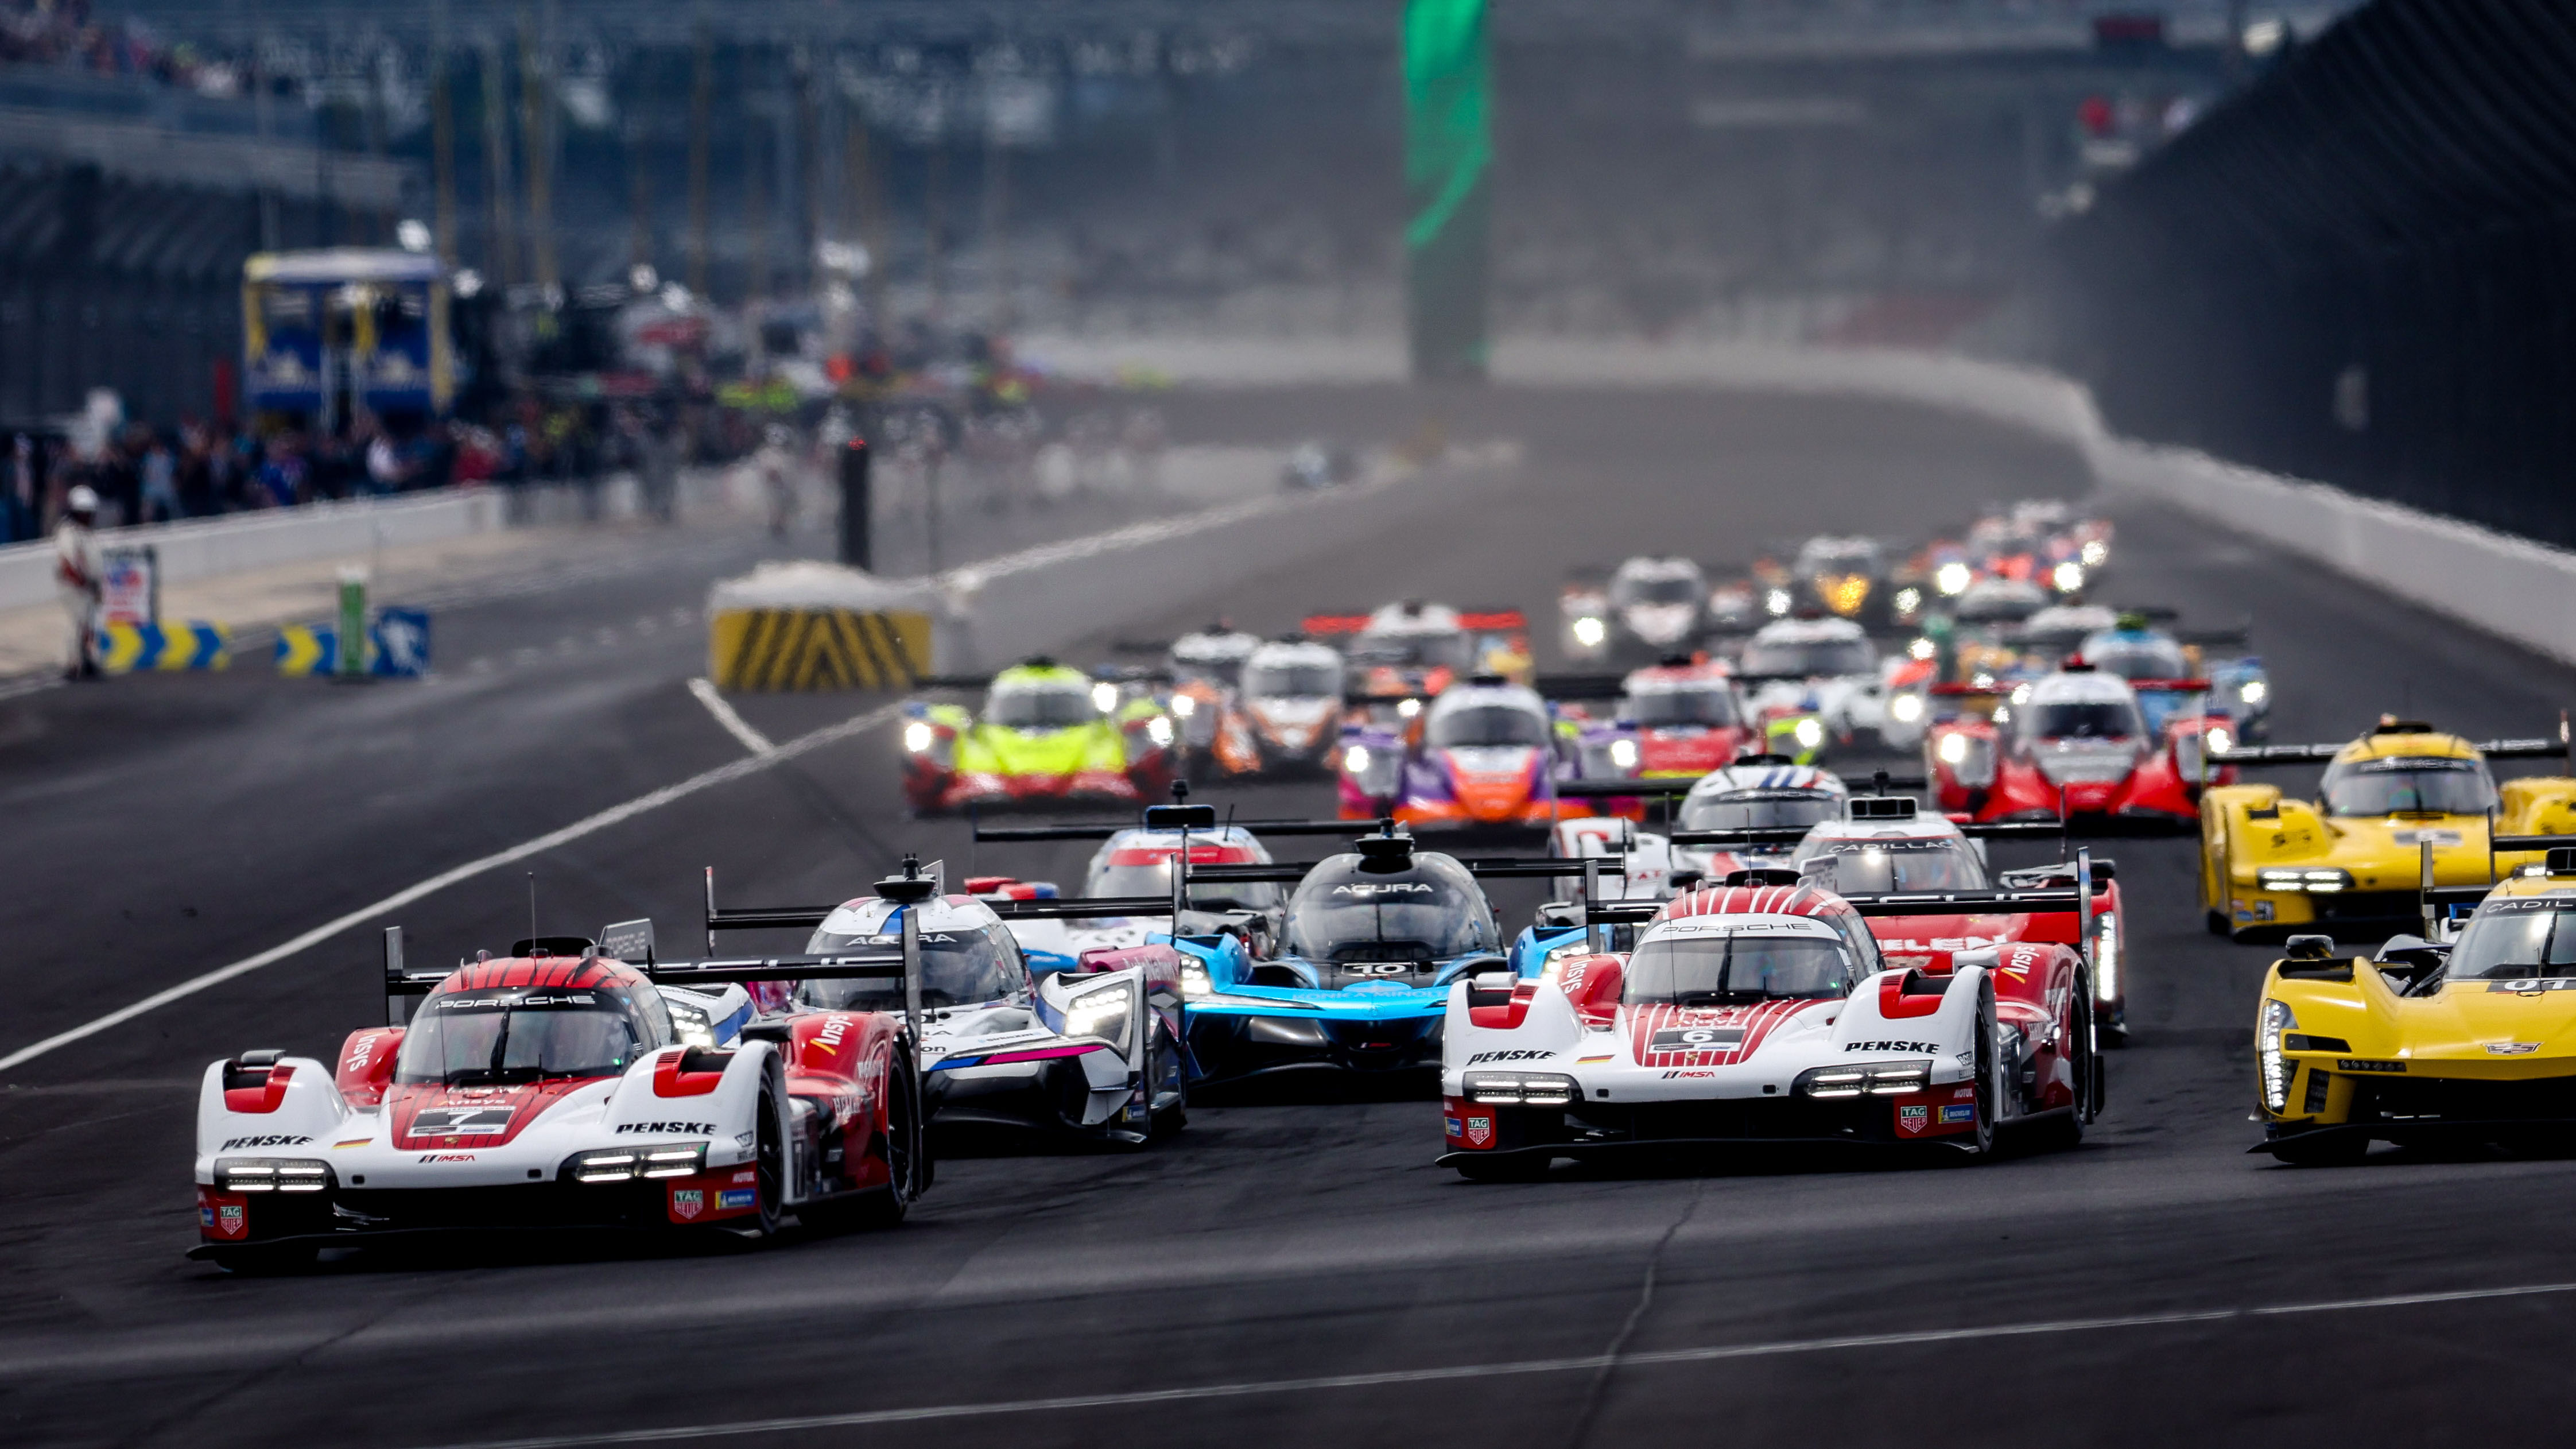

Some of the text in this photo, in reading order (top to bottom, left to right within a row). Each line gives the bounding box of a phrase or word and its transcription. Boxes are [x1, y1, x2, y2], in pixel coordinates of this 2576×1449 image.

[1828, 841, 1953, 853] CADILLAC
[1332, 884, 1433, 894] ACURA
[1661, 923, 1812, 934] PORSCHE
[1353, 964, 1406, 974] 10
[2000, 945, 2040, 985] Ansys
[2504, 979, 2567, 990] 01
[1293, 991, 1367, 1000] KONICA
[435, 995, 596, 1010] PORSCHE
[810, 1014, 854, 1056] Ansys
[1682, 1030, 1714, 1043] 6
[1844, 1041, 1939, 1055] PENSKE
[1466, 1050, 1557, 1066] PENSKE
[1953, 1088, 1973, 1098] MOTUL
[1903, 1108, 1925, 1116] TAG
[448, 1111, 483, 1126] 7
[1469, 1119, 1488, 1128] TAG
[615, 1122, 717, 1136] PENSKE
[1902, 1118, 1926, 1132] HEUER
[1469, 1129, 1489, 1142] HEUER
[220, 1135, 314, 1152] PENSKE
[678, 1192, 702, 1202] TAG
[222, 1208, 240, 1217] TAG
